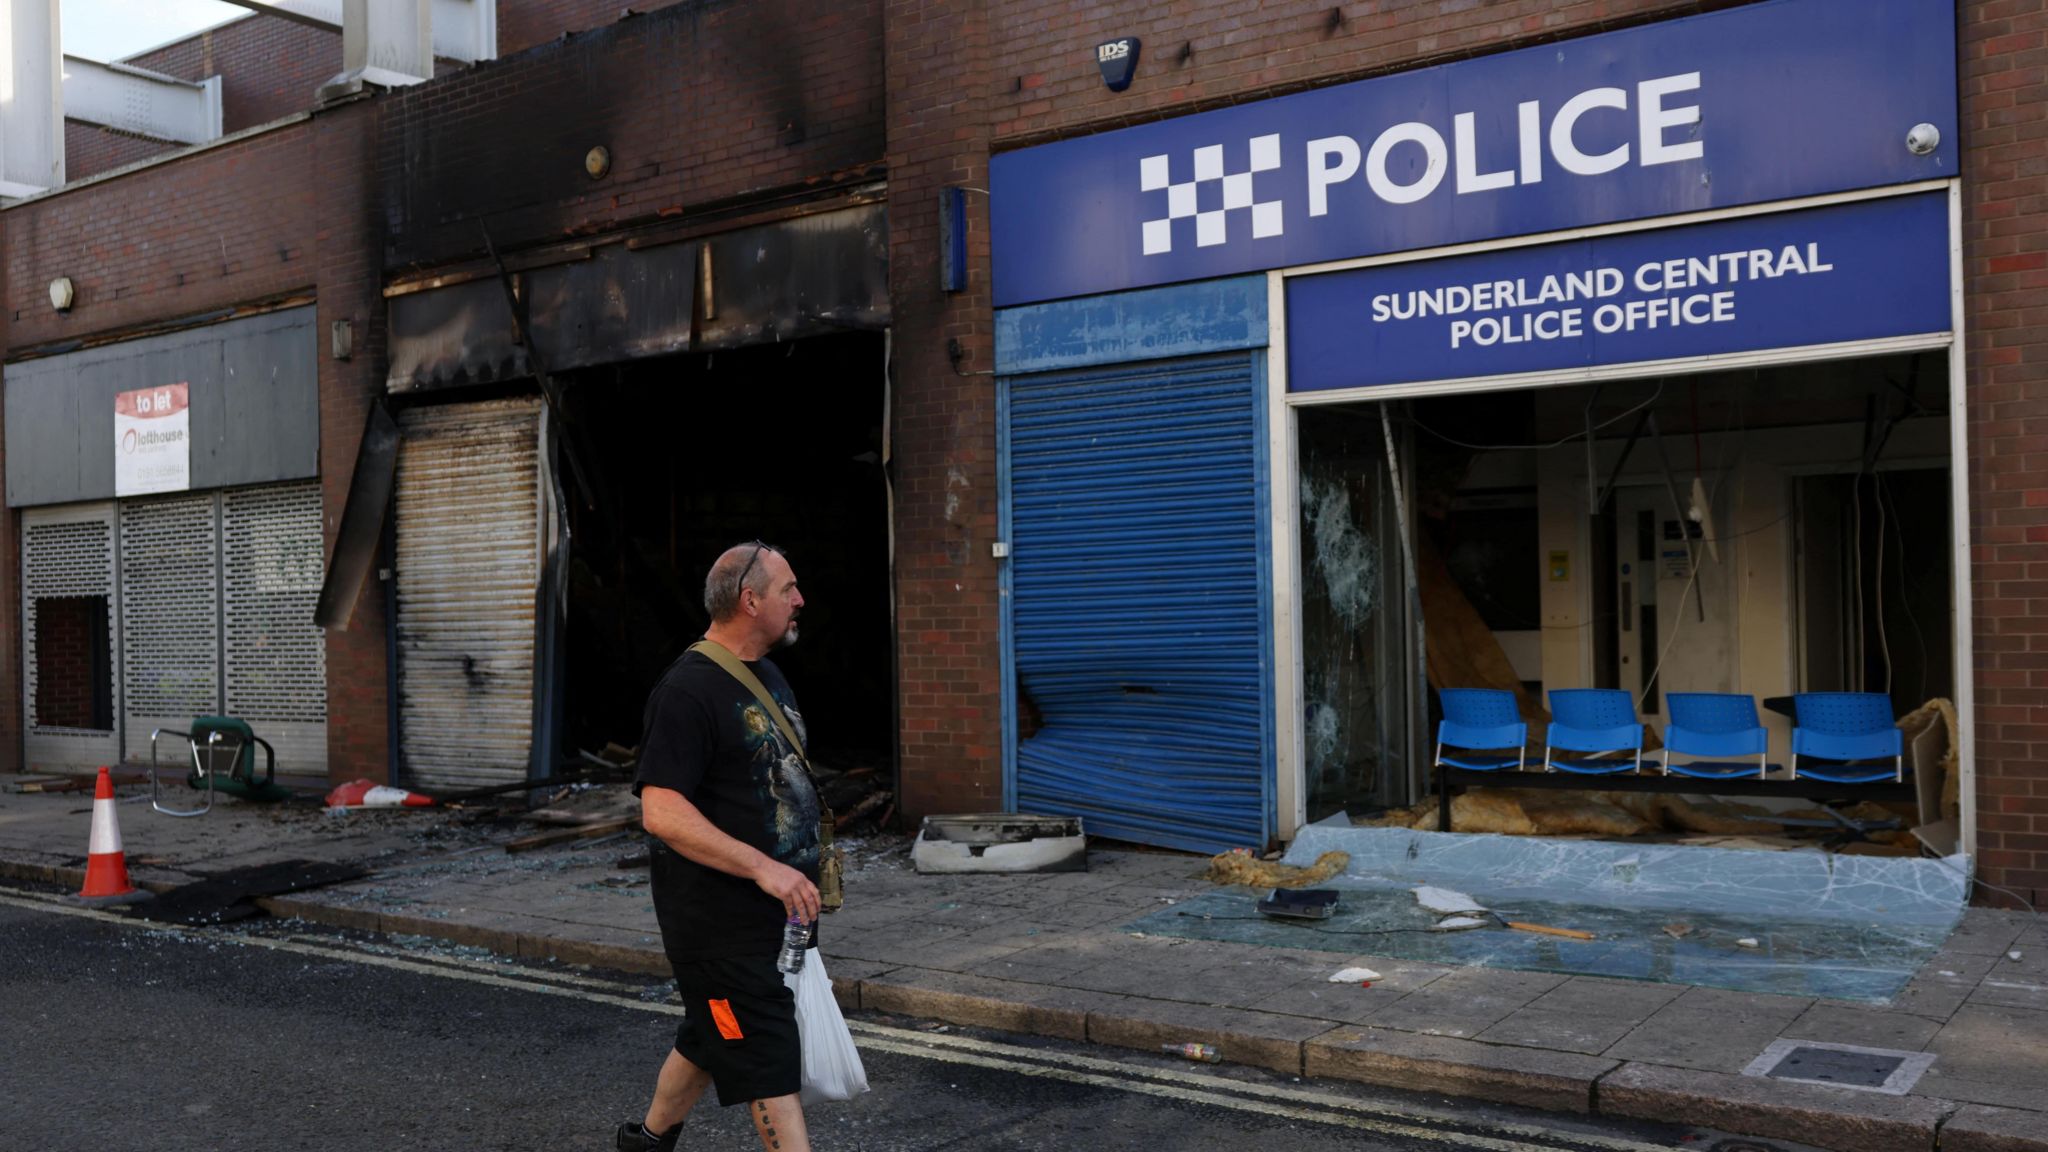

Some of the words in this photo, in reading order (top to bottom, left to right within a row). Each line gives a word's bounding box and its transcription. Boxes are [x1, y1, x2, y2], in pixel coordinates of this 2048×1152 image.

[1098, 39, 1129, 58] IDS
[1306, 71, 1704, 217] POLICE
[1372, 267, 1624, 322] SUNDERLAND
[1634, 242, 1833, 292] CENTRAL
[1451, 308, 1583, 349] POLICE
[1593, 291, 1735, 333] OFFICE
[136, 394, 151, 414] to
[153, 390, 172, 411] let
[137, 429, 183, 447] lofthouse
